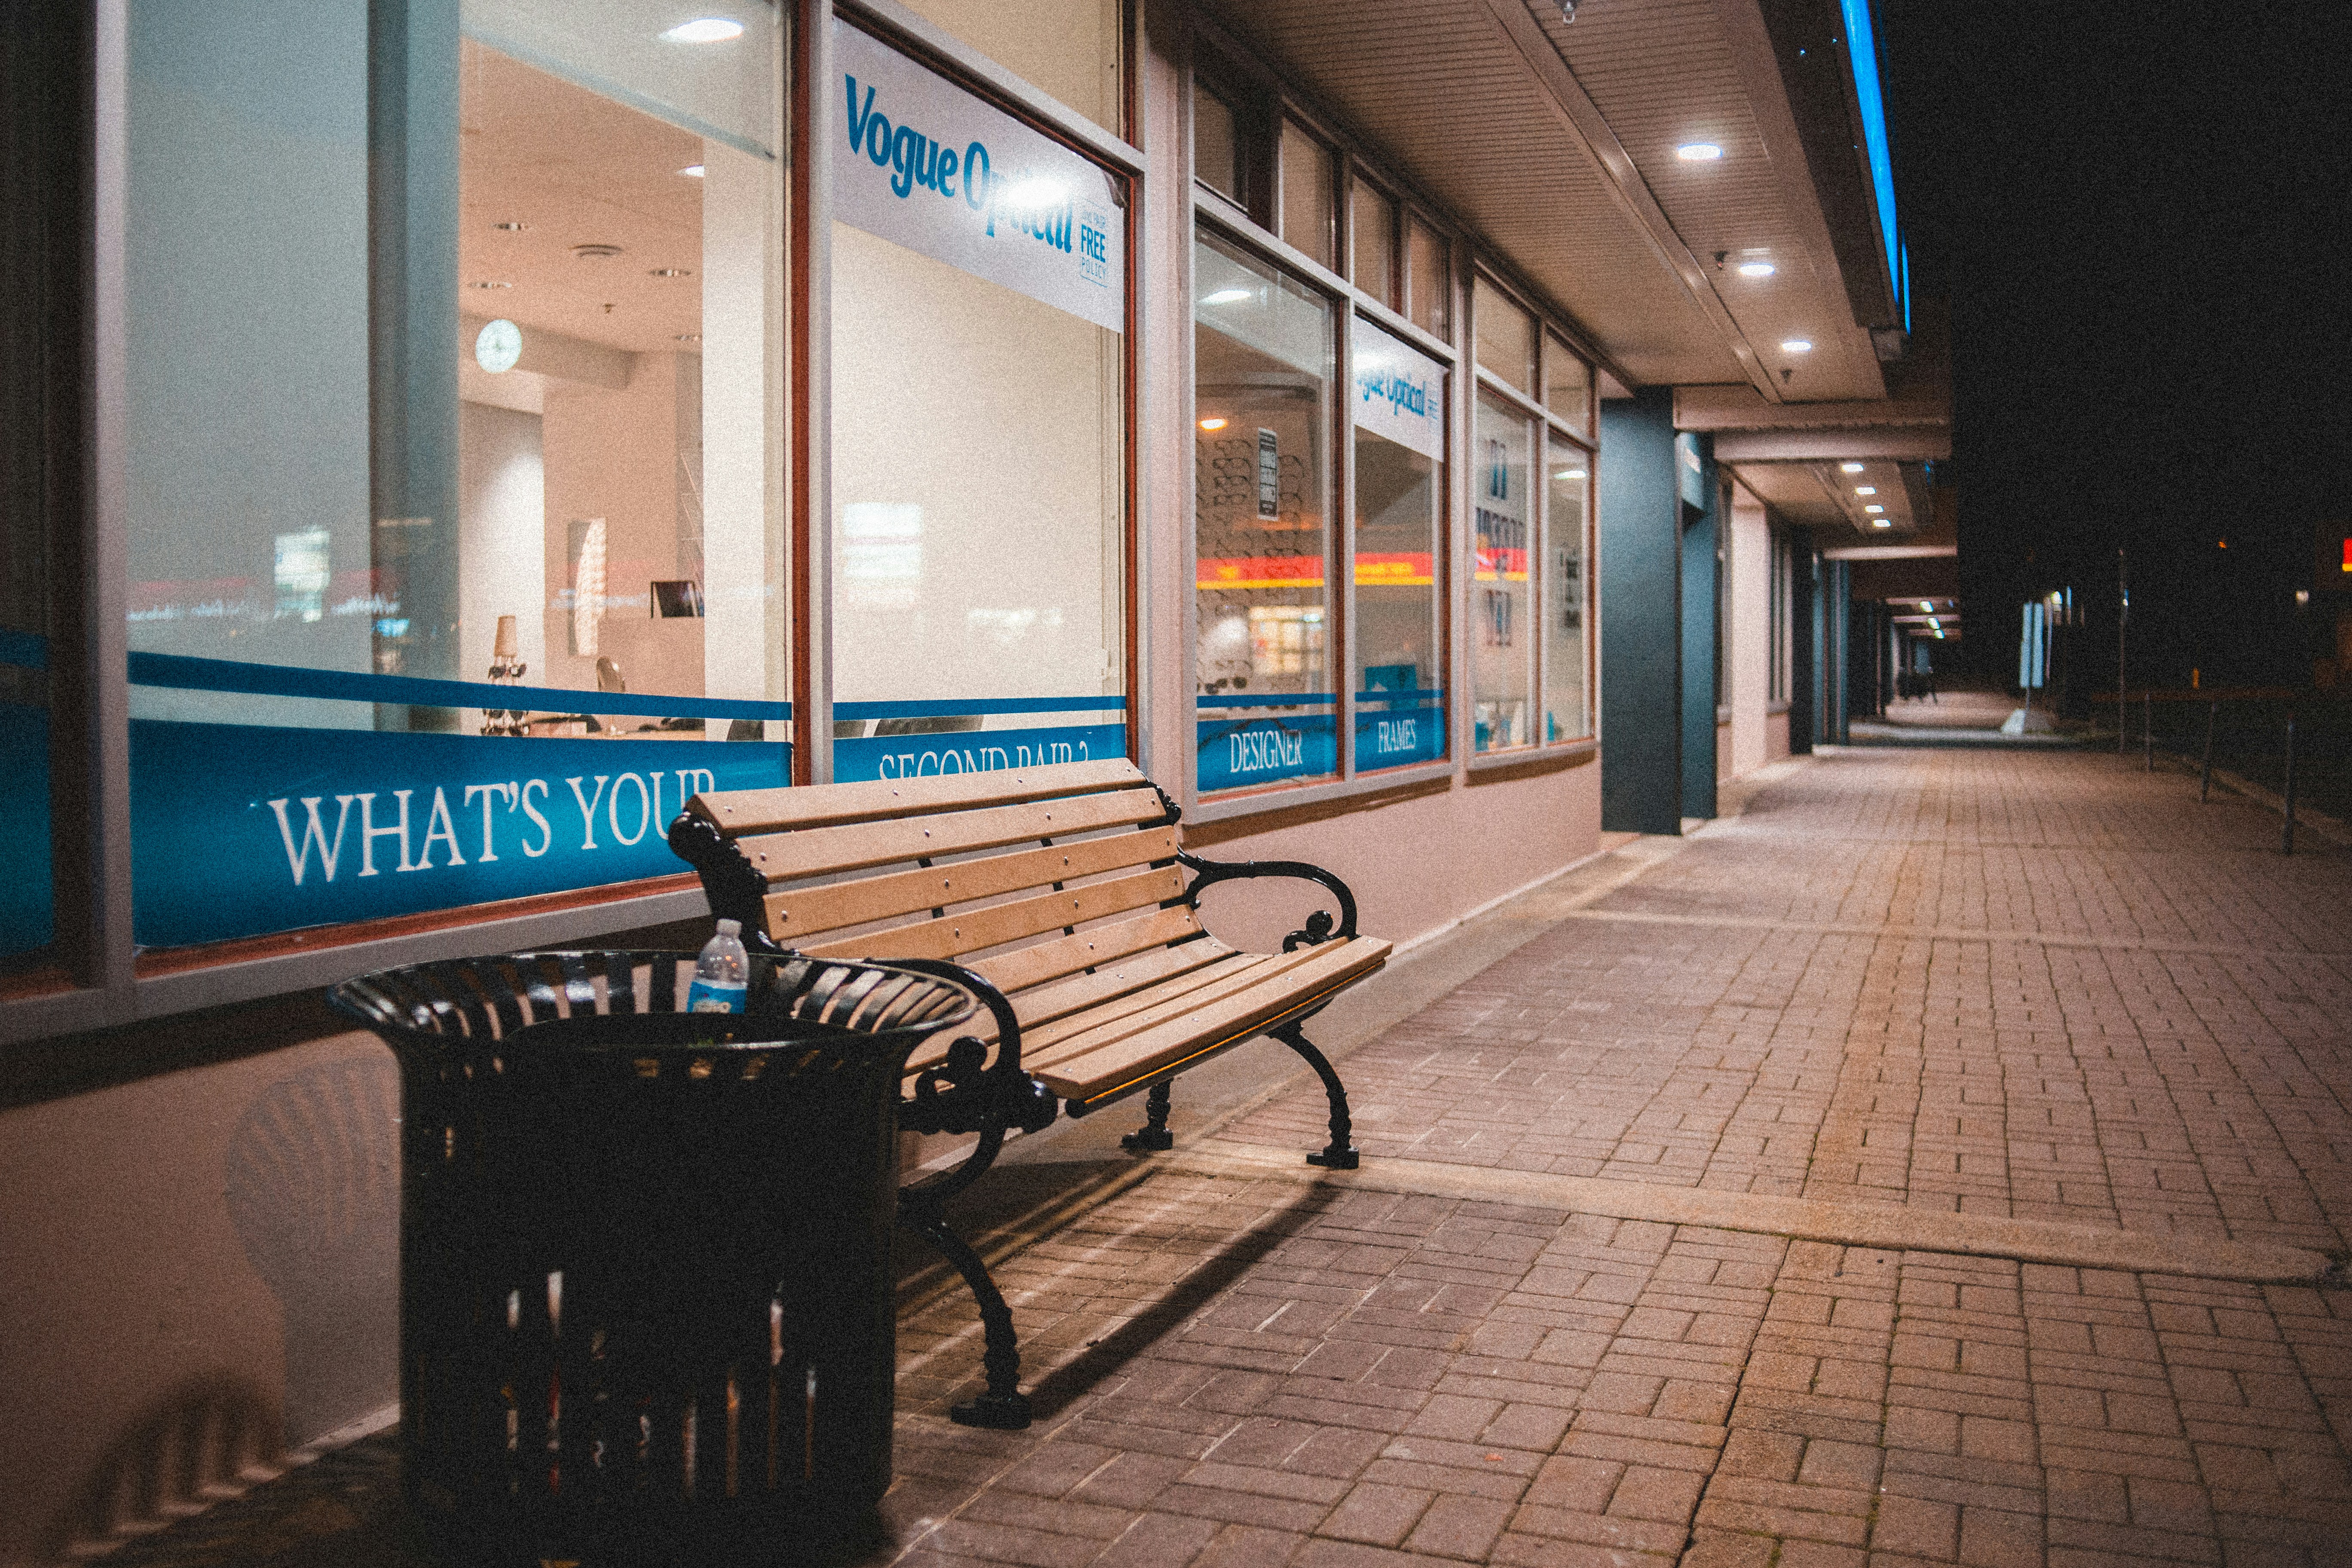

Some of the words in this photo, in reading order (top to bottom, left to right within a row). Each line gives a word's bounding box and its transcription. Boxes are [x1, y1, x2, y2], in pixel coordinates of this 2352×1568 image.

[845, 74, 958, 199] Vogue
[964, 141, 1072, 254] Opcal
[1081, 224, 1106, 263] FREE
[1081, 257, 1107, 280] POLICY
[1230, 730, 1303, 773] DESIGNER
[1378, 719, 1416, 753] FRAMES
[267, 778, 552, 885] WHAT'S
